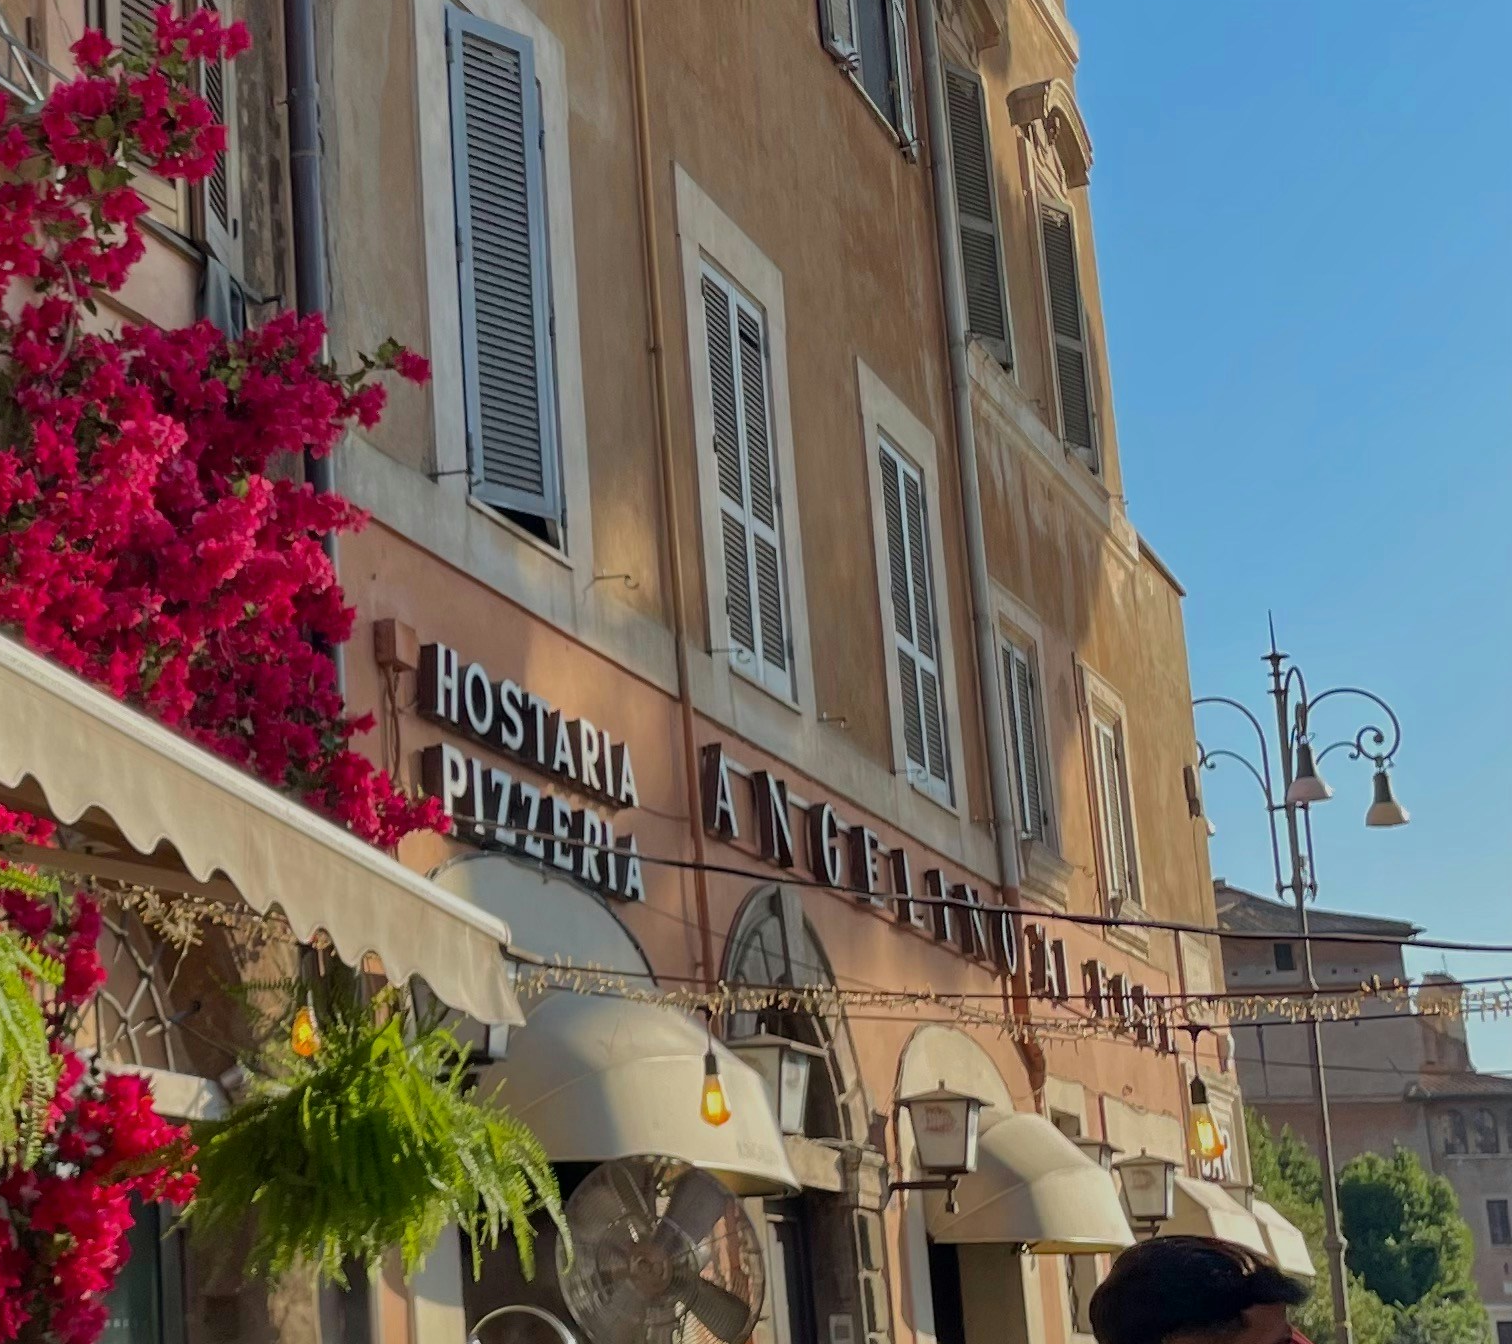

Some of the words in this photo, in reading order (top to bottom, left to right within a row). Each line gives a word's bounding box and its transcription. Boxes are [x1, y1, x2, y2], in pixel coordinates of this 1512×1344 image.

[435, 640, 640, 808] HOSTARIA
[440, 741, 646, 903] PIZZERIA
[713, 749, 1017, 976] ANGELINO
